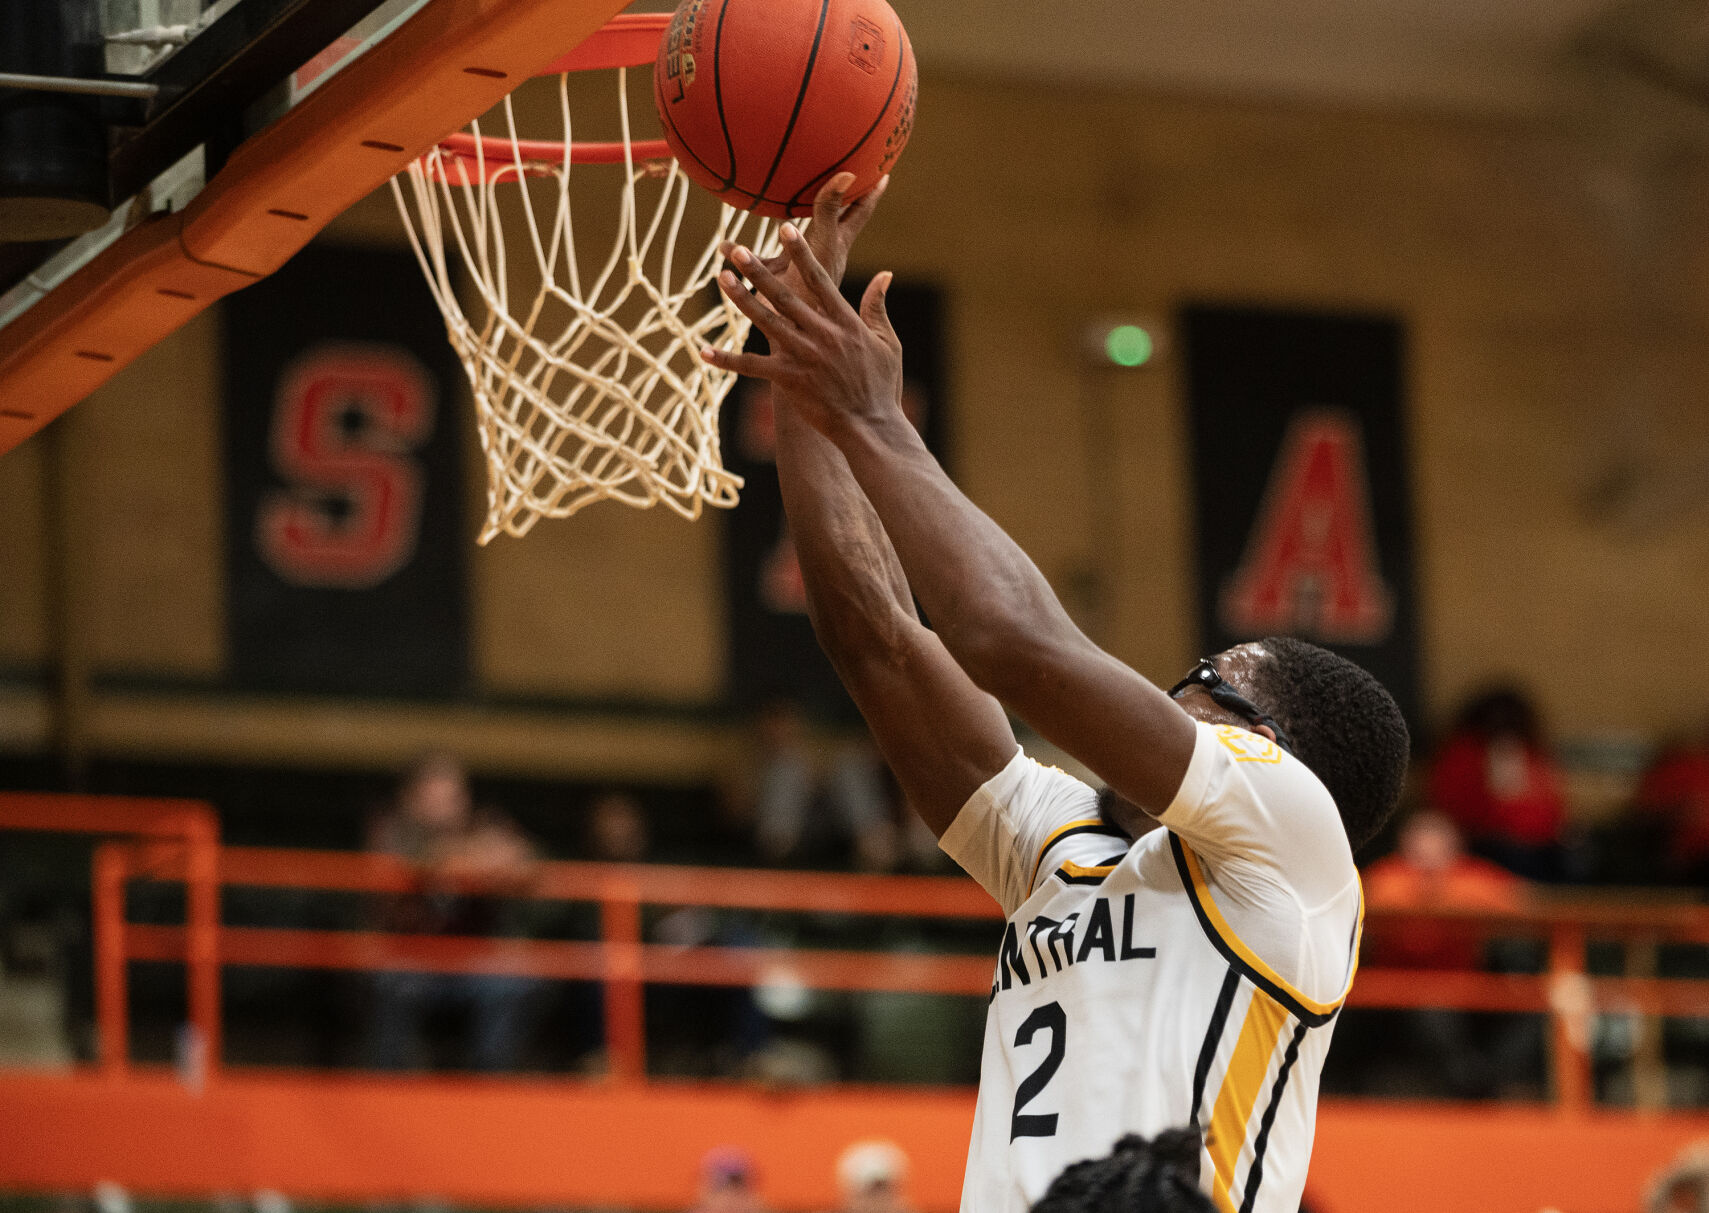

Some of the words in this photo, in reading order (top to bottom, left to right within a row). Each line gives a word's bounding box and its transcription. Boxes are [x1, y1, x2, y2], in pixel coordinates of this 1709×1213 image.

[255, 343, 435, 587] S
[1219, 408, 1393, 644] A
[989, 893, 1156, 1004] NTRAL
[1010, 1001, 1067, 1145] 2
